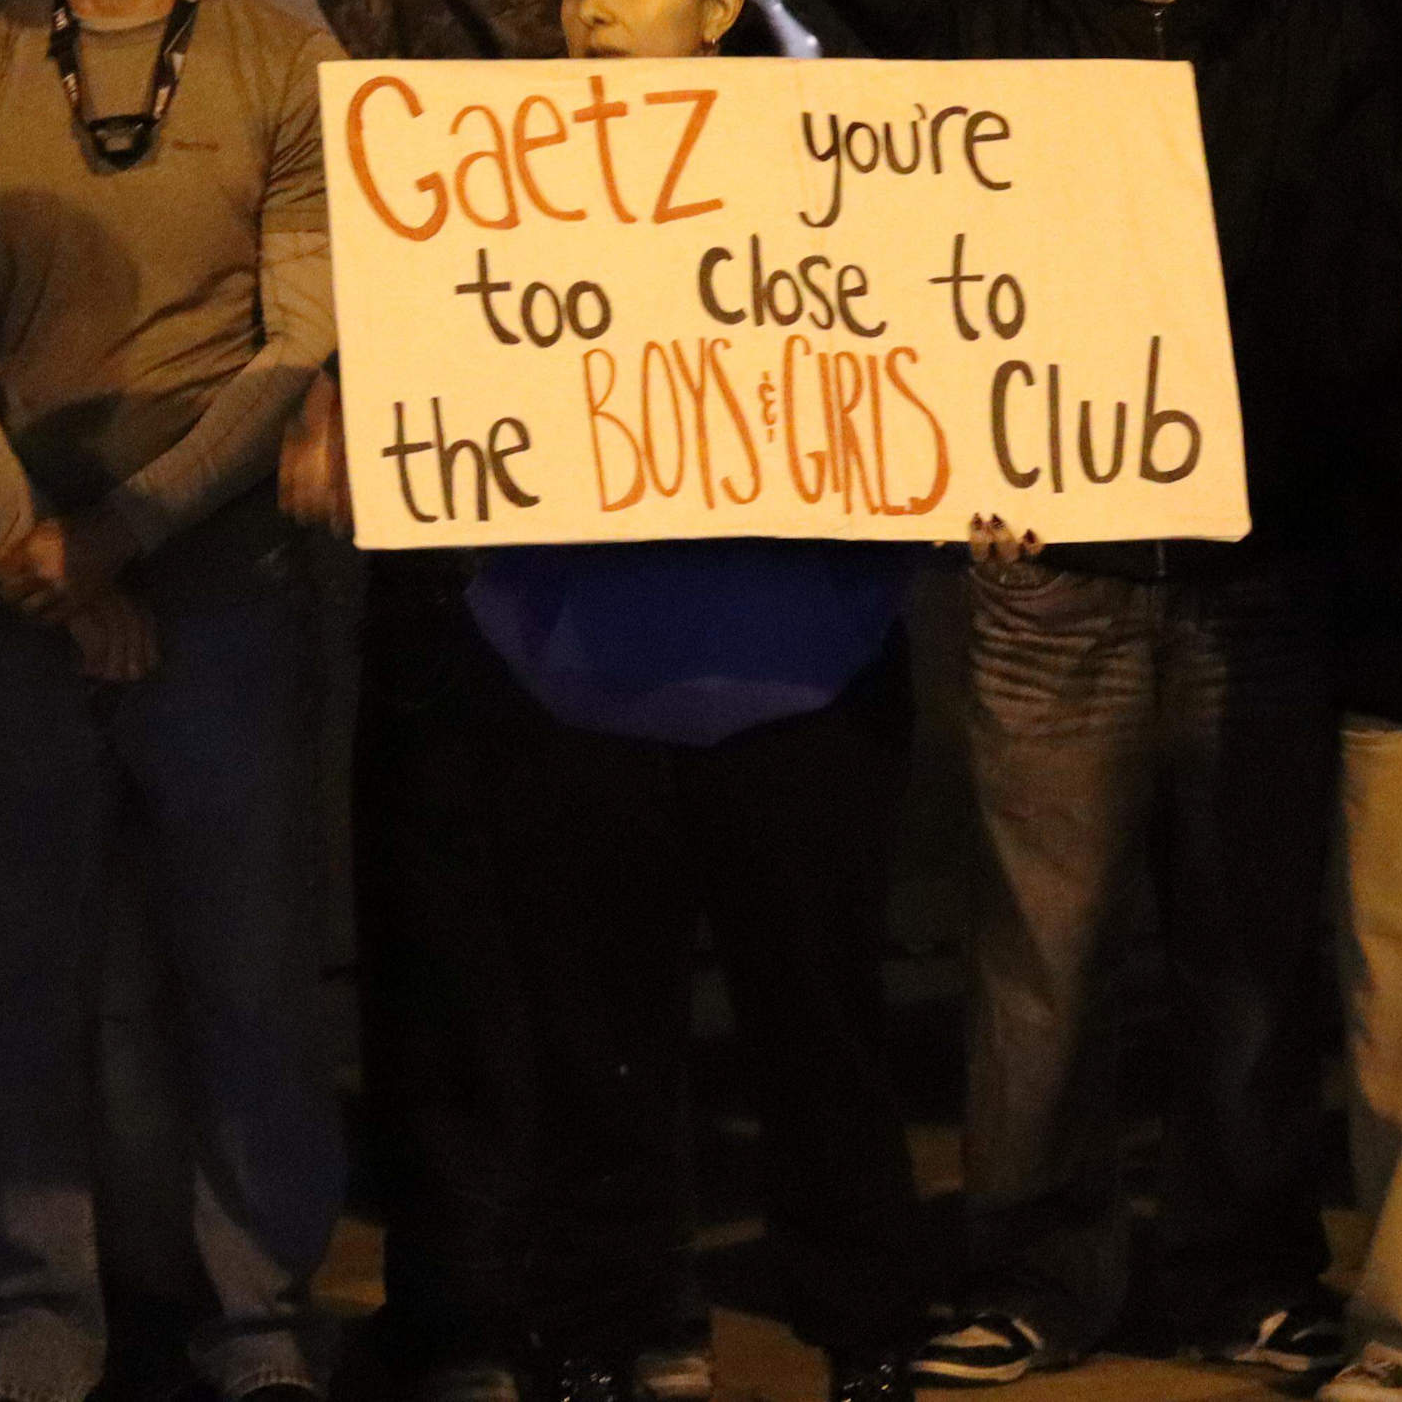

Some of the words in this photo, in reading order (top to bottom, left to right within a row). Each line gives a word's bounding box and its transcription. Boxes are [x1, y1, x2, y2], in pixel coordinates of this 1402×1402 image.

[345, 74, 724, 242] Gaetz
[799, 103, 1012, 228] you're
[455, 248, 612, 348] too
[928, 233, 1025, 341] to
[382, 397, 542, 523] the
